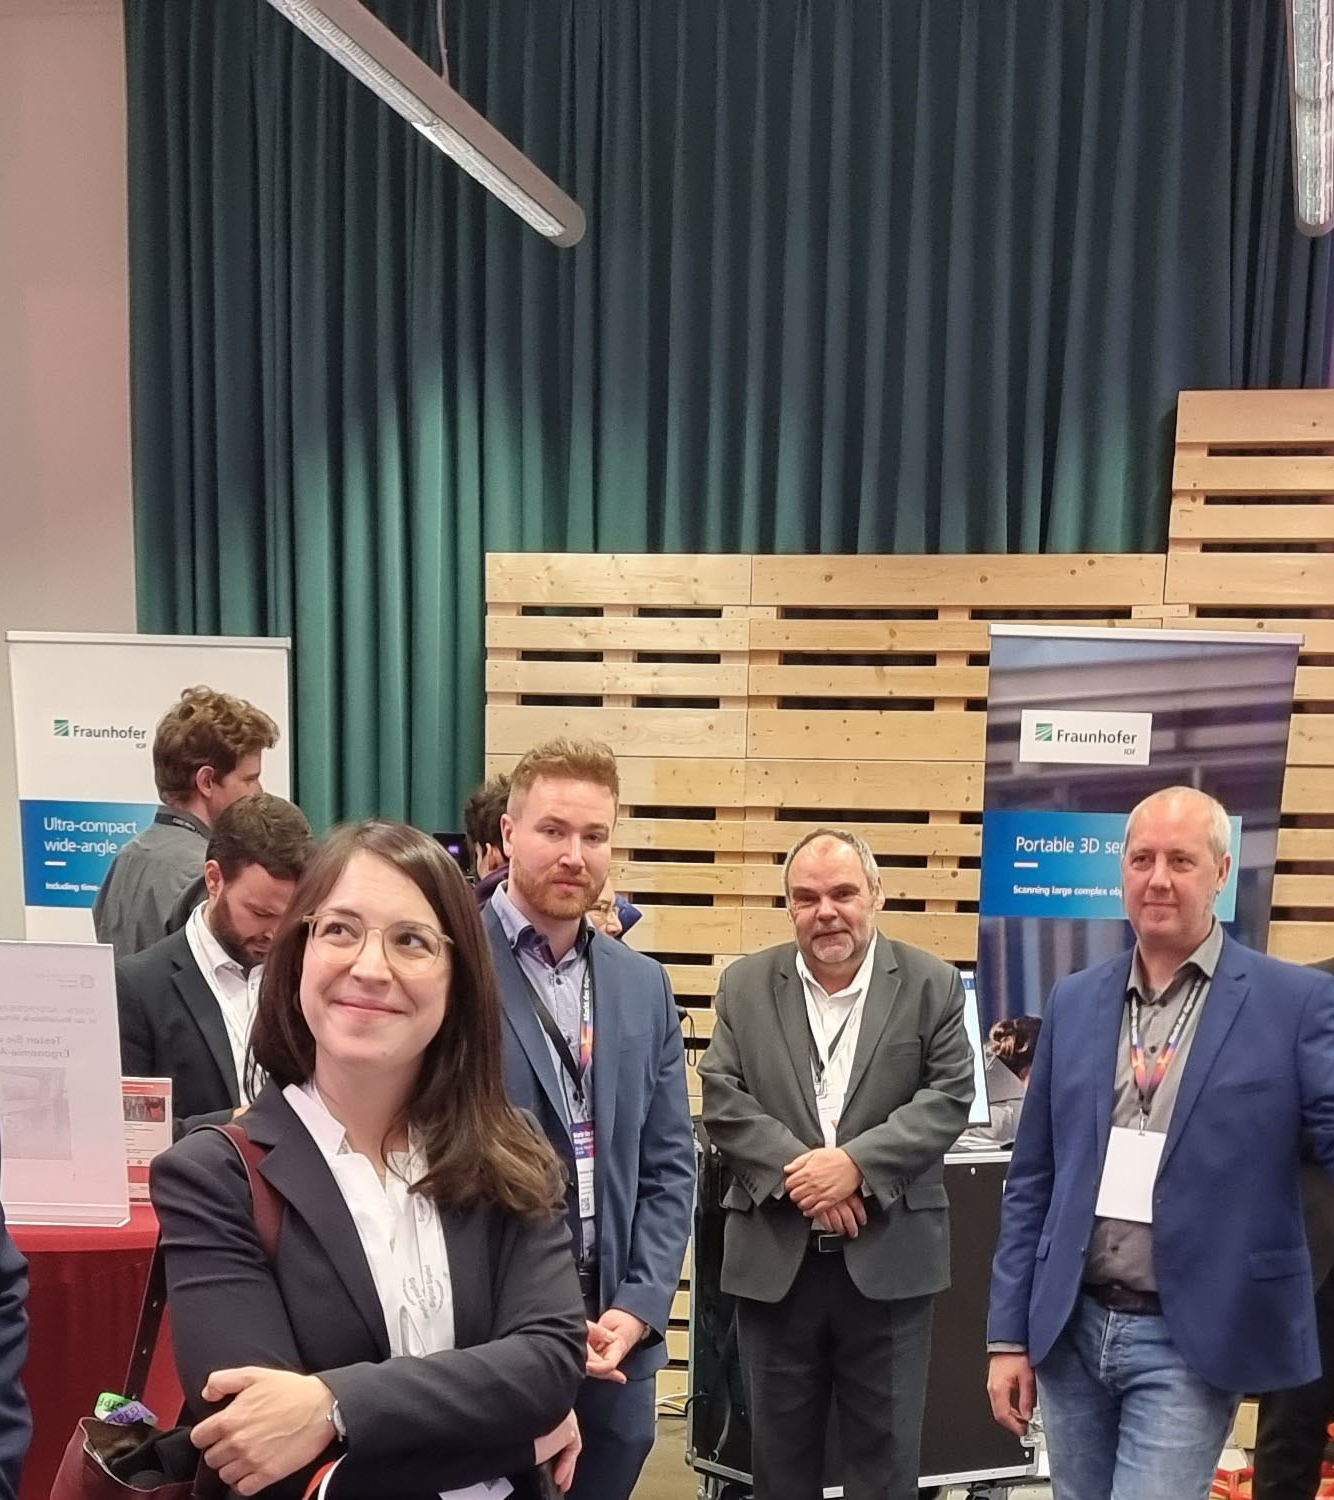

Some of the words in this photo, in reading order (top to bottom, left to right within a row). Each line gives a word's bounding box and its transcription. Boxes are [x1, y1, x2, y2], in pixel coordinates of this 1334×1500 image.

[73, 725, 147, 739] Fraunhofer
[1057, 729, 1137, 744] Fraunhofer
[43, 816, 138, 836] Ultra-compact
[43, 837, 118, 857] wide-angle
[1015, 836, 1075, 853] Portable
[1079, 837, 1100, 854] 3D
[1013, 885, 1050, 897] Scanning
[1052, 886, 1072, 897] large
[1074, 887, 1107, 897] complex
